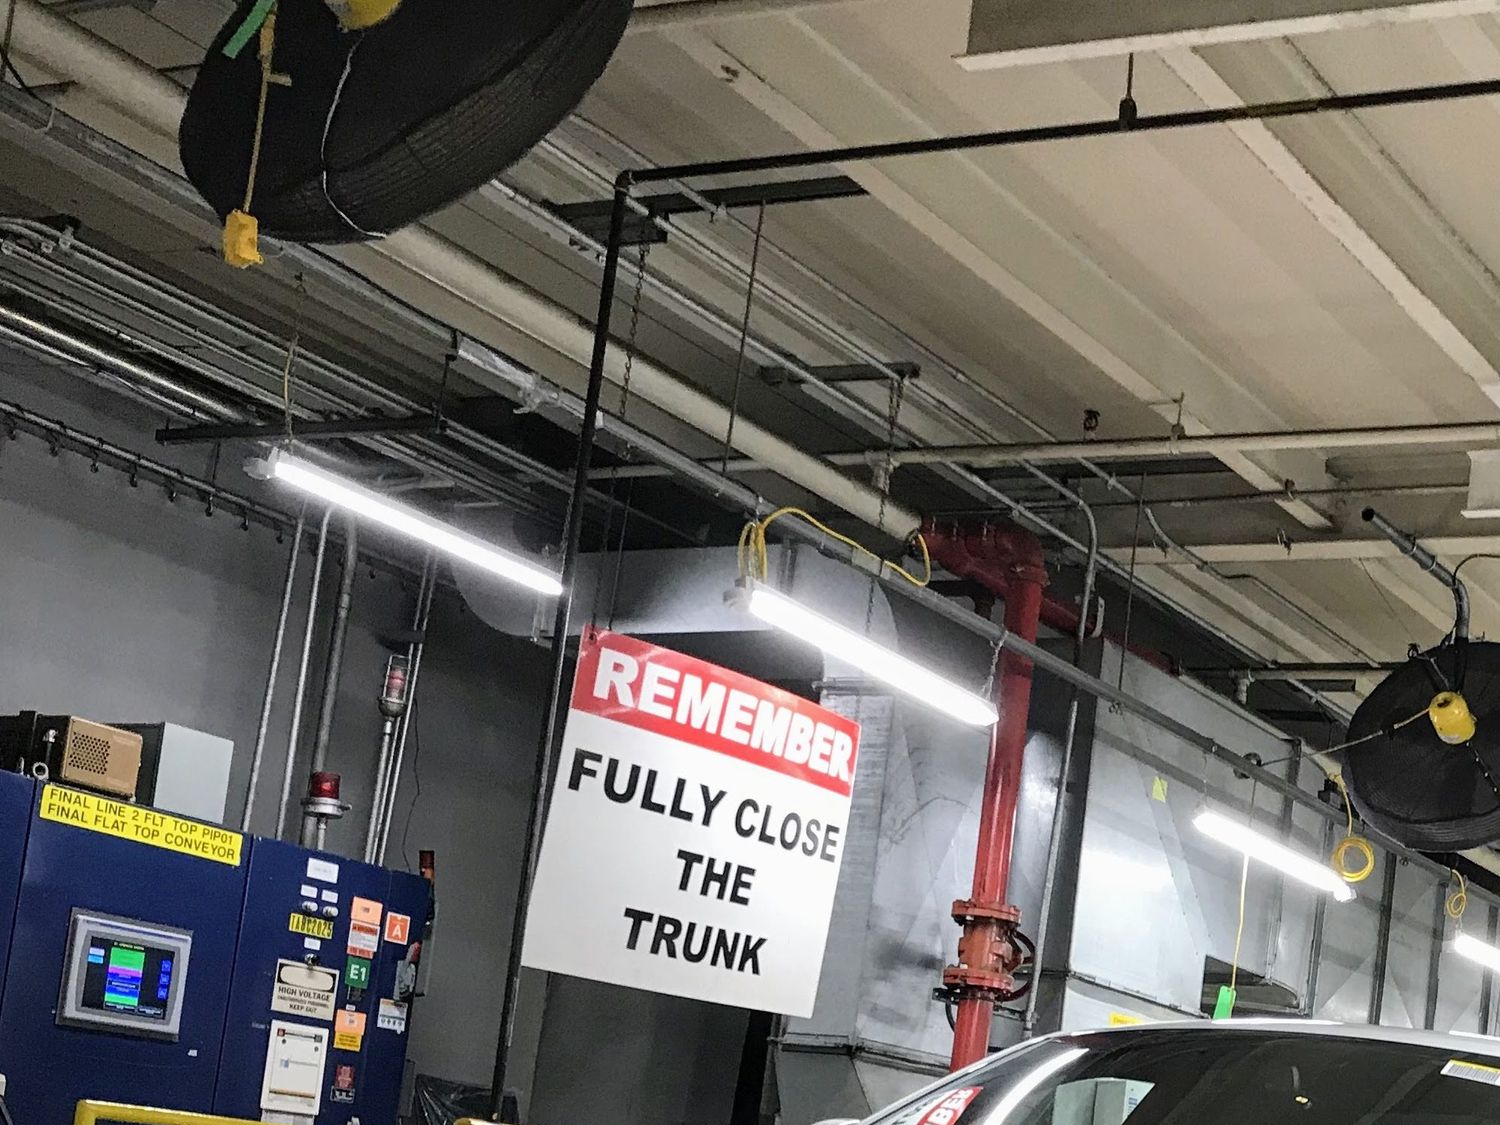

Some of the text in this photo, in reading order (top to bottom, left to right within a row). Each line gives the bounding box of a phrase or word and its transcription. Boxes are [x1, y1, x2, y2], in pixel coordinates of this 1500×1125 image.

[592, 647, 853, 782] REMEMBER
[47, 802, 235, 861] FINAL FLAT TOP CONVEYOR
[50, 788, 234, 846] FINAL LINE 2 FLT TOP PIP01
[567, 748, 840, 864] FULLY CLOSE
[676, 849, 757, 906] THE
[392, 926, 402, 939] A
[622, 907, 768, 976] TRUNK
[278, 986, 297, 997] HIGH
[299, 989, 331, 1002] VOLTAGE
[350, 964, 366, 982] E1
